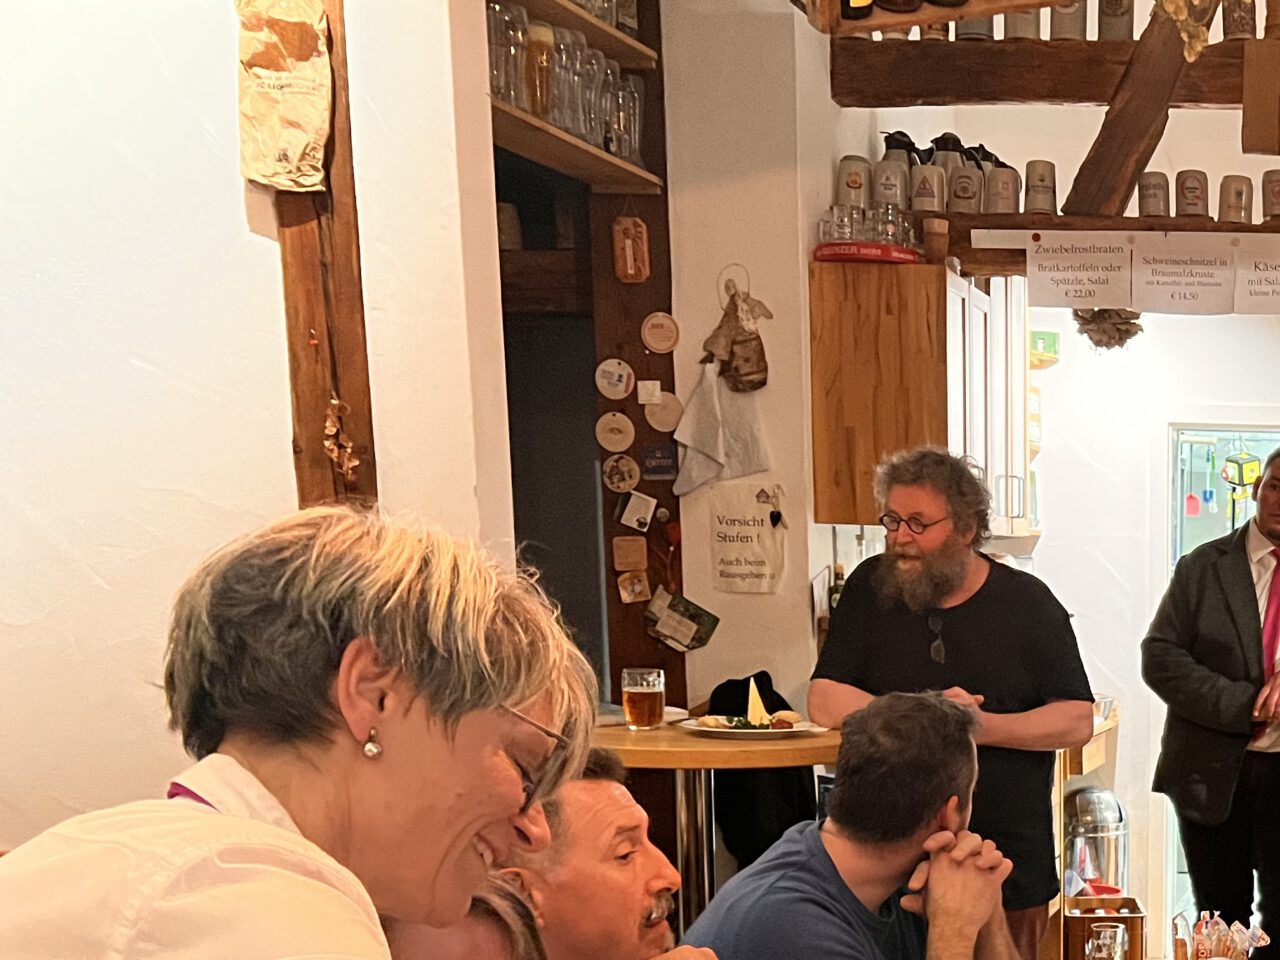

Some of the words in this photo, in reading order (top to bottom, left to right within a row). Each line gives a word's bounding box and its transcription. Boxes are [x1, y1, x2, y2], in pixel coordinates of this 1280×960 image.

[1034, 243, 1124, 255] Zwiebelrostbraten
[1142, 256, 1217, 266] Schweineschnitzel
[1037, 263, 1099, 273] Bratkartoffeln
[1101, 263, 1123, 273] oder
[1087, 276, 1109, 286] Salat
[1247, 277, 1262, 286] mit
[716, 515, 765, 527] Vorsicht
[716, 531, 753, 543] Stufen
[719, 557, 743, 566] Auch
[744, 557, 767, 567] beim
